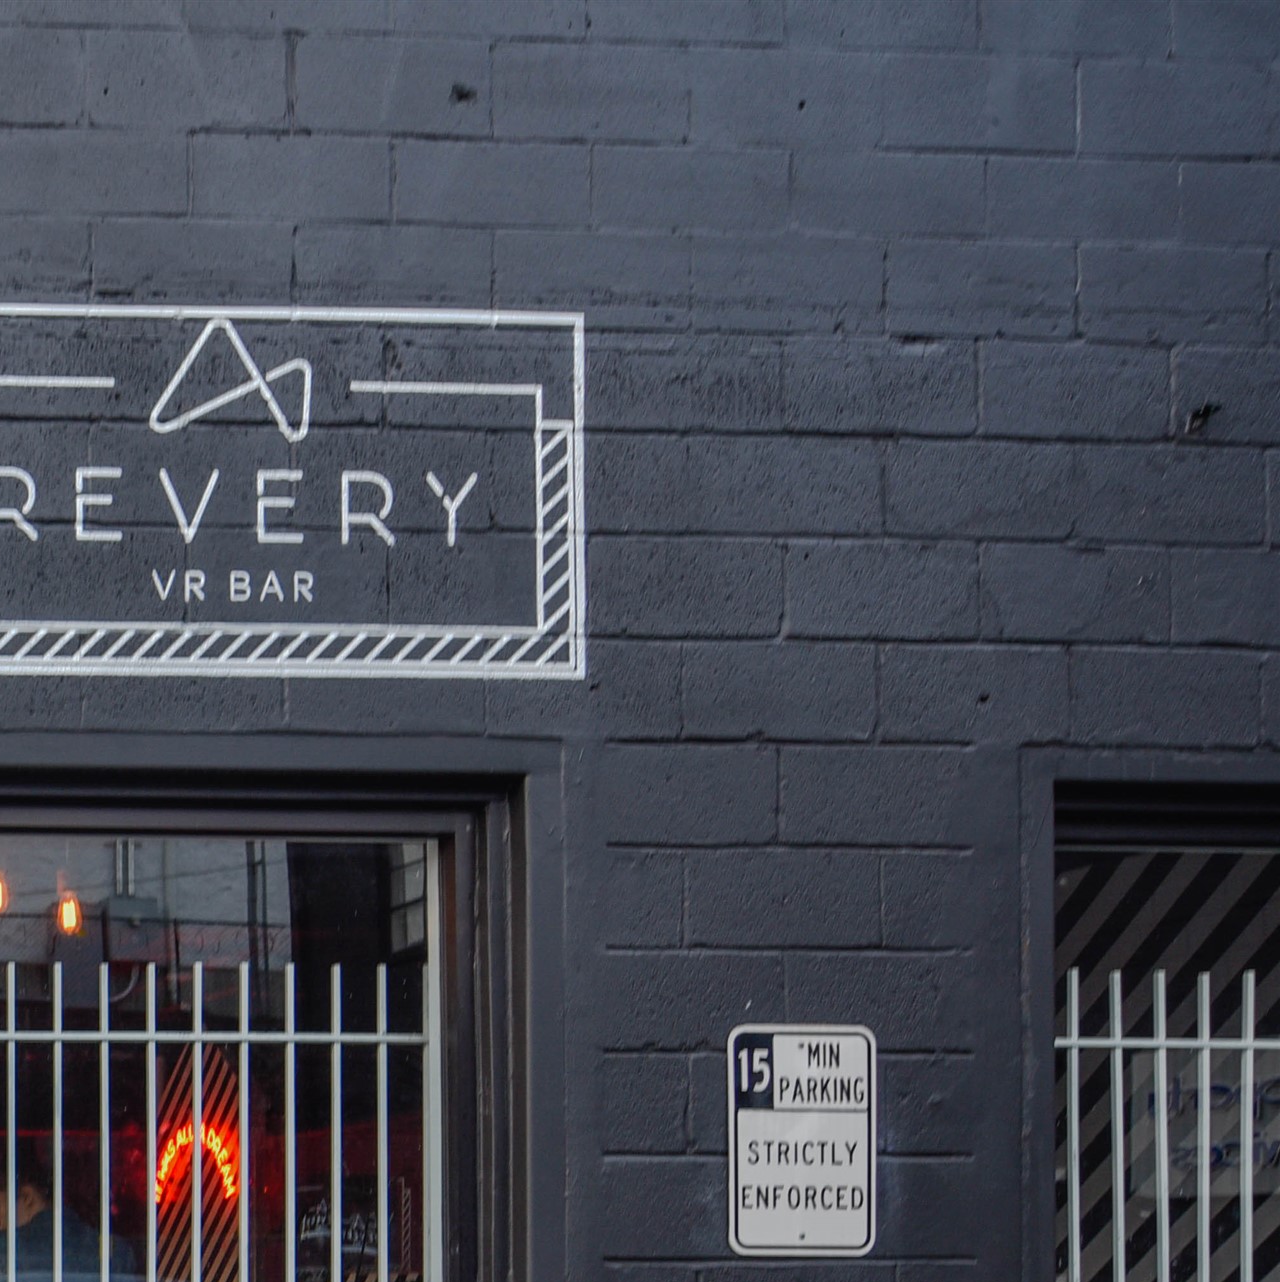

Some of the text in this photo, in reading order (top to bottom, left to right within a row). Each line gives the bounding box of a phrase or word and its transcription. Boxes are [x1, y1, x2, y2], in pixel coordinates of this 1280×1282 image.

[151, 568, 315, 603] VR BAR
[807, 1042, 841, 1069] MIN
[738, 1048, 771, 1093] 15
[778, 1076, 865, 1104] PARKING
[747, 1140, 858, 1167] STRICTLY
[741, 1184, 864, 1211] ENFORCED
